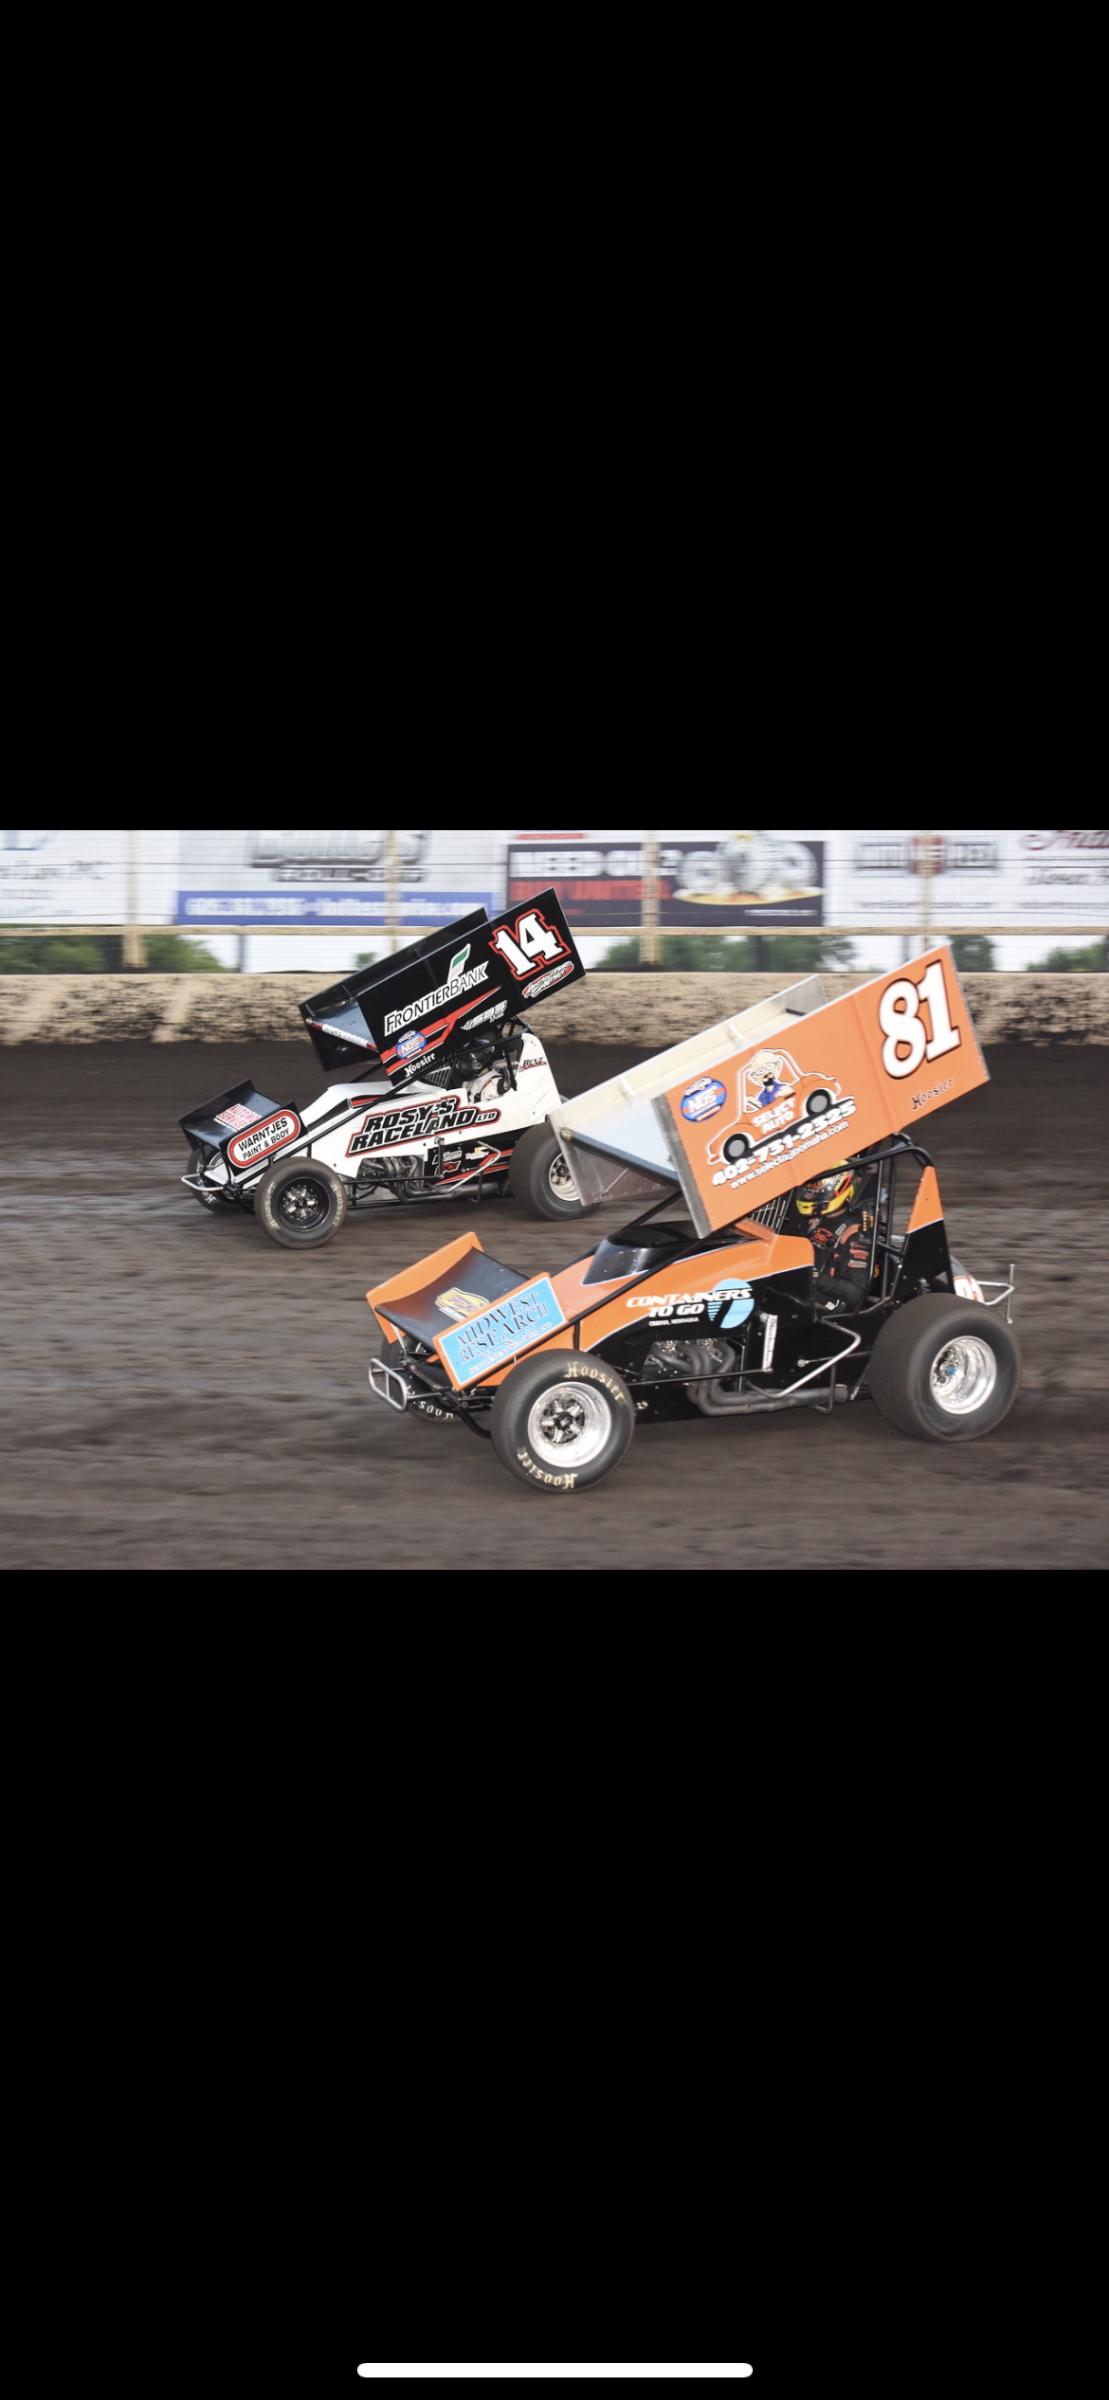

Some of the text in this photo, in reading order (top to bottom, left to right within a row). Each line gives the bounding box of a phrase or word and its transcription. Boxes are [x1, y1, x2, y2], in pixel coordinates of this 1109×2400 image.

[492, 911, 567, 978] 14
[879, 959, 961, 1080] 81
[404, 1053, 436, 1077] Hoosier
[911, 1079, 953, 1109] Hoosier
[351, 1108, 477, 1151] RACELAND
[364, 1098, 457, 1133] ROSY'S
[477, 1111, 497, 1122] LTD
[752, 1099, 796, 1126] SELECT
[761, 1110, 794, 1134] AUTO
[238, 1117, 288, 1151] WARNTJES
[242, 1128, 290, 1160] PAINT & BODY
[711, 1101, 857, 1186] 402-731-2325
[626, 1288, 754, 1308] CONTAINERS
[648, 1303, 705, 1318] TO GO
[456, 1291, 540, 1345] MIDWEST
[459, 1303, 550, 1363] RESEARCH
[563, 1361, 627, 1405] Hoosier
[516, 1447, 578, 1489] Hoosier
